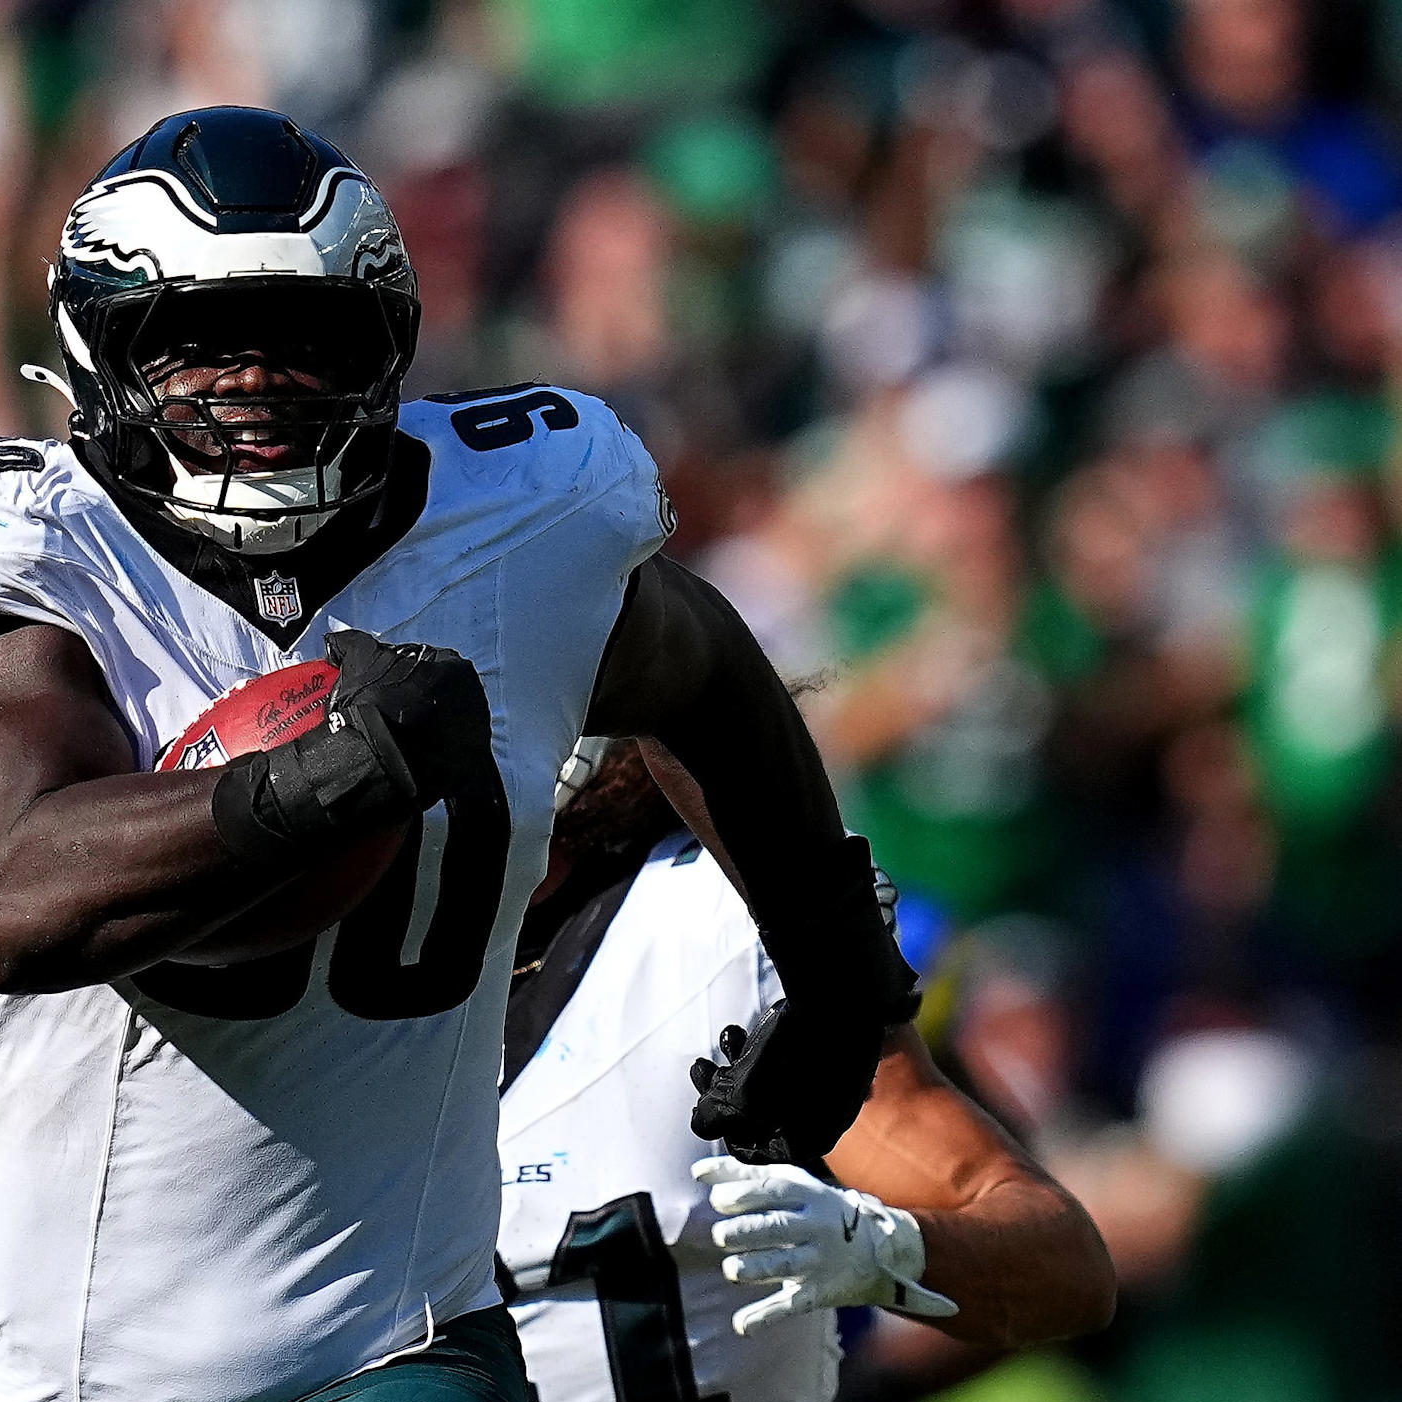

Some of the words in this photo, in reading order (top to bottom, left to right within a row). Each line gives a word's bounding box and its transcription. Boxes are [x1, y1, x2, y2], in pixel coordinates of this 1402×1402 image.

[427, 381, 579, 452] 9
[265, 595, 296, 616] NFL
[262, 691, 332, 743] COMMISSION
